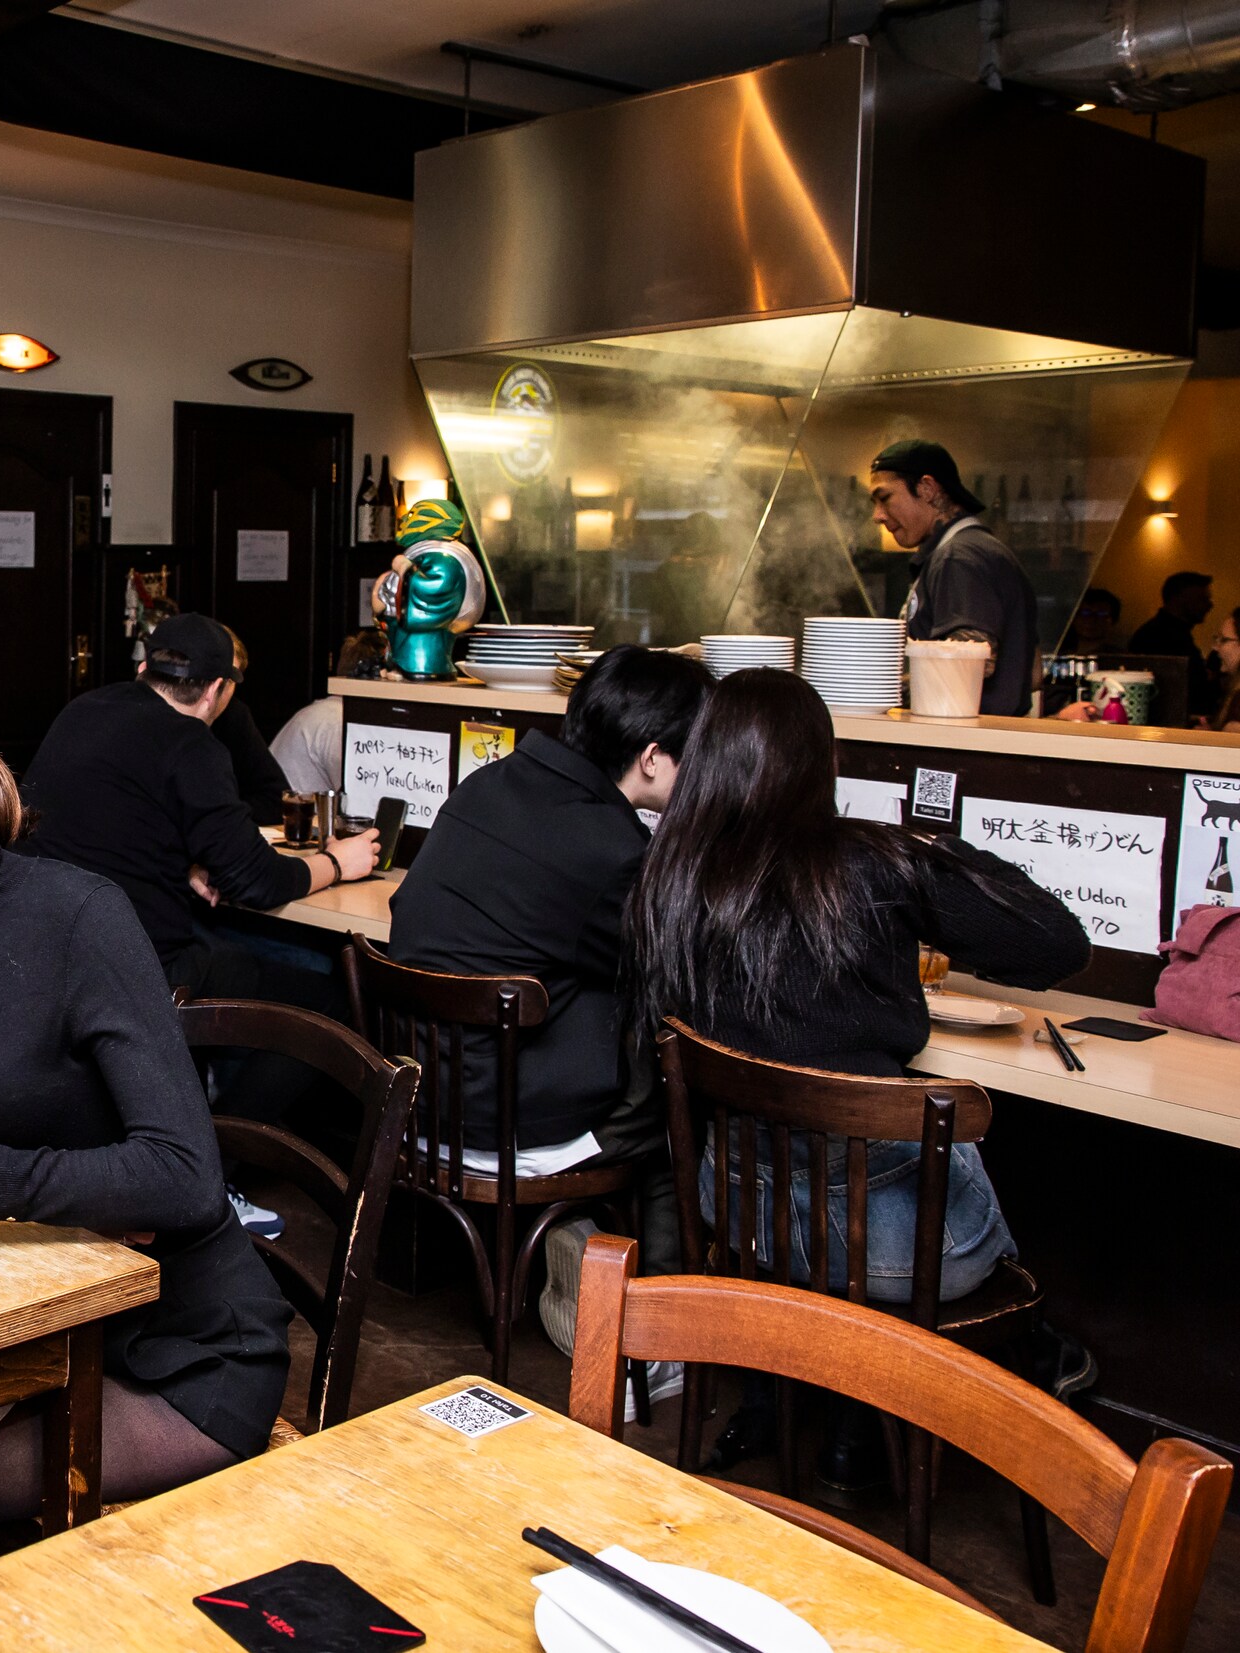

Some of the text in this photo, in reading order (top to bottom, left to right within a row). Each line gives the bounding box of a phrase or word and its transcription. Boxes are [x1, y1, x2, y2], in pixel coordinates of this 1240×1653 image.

[355, 766, 380, 788] Spicy
[982, 816, 1155, 855] 明太釜揚げうどん
[1077, 886, 1128, 909] Udon
